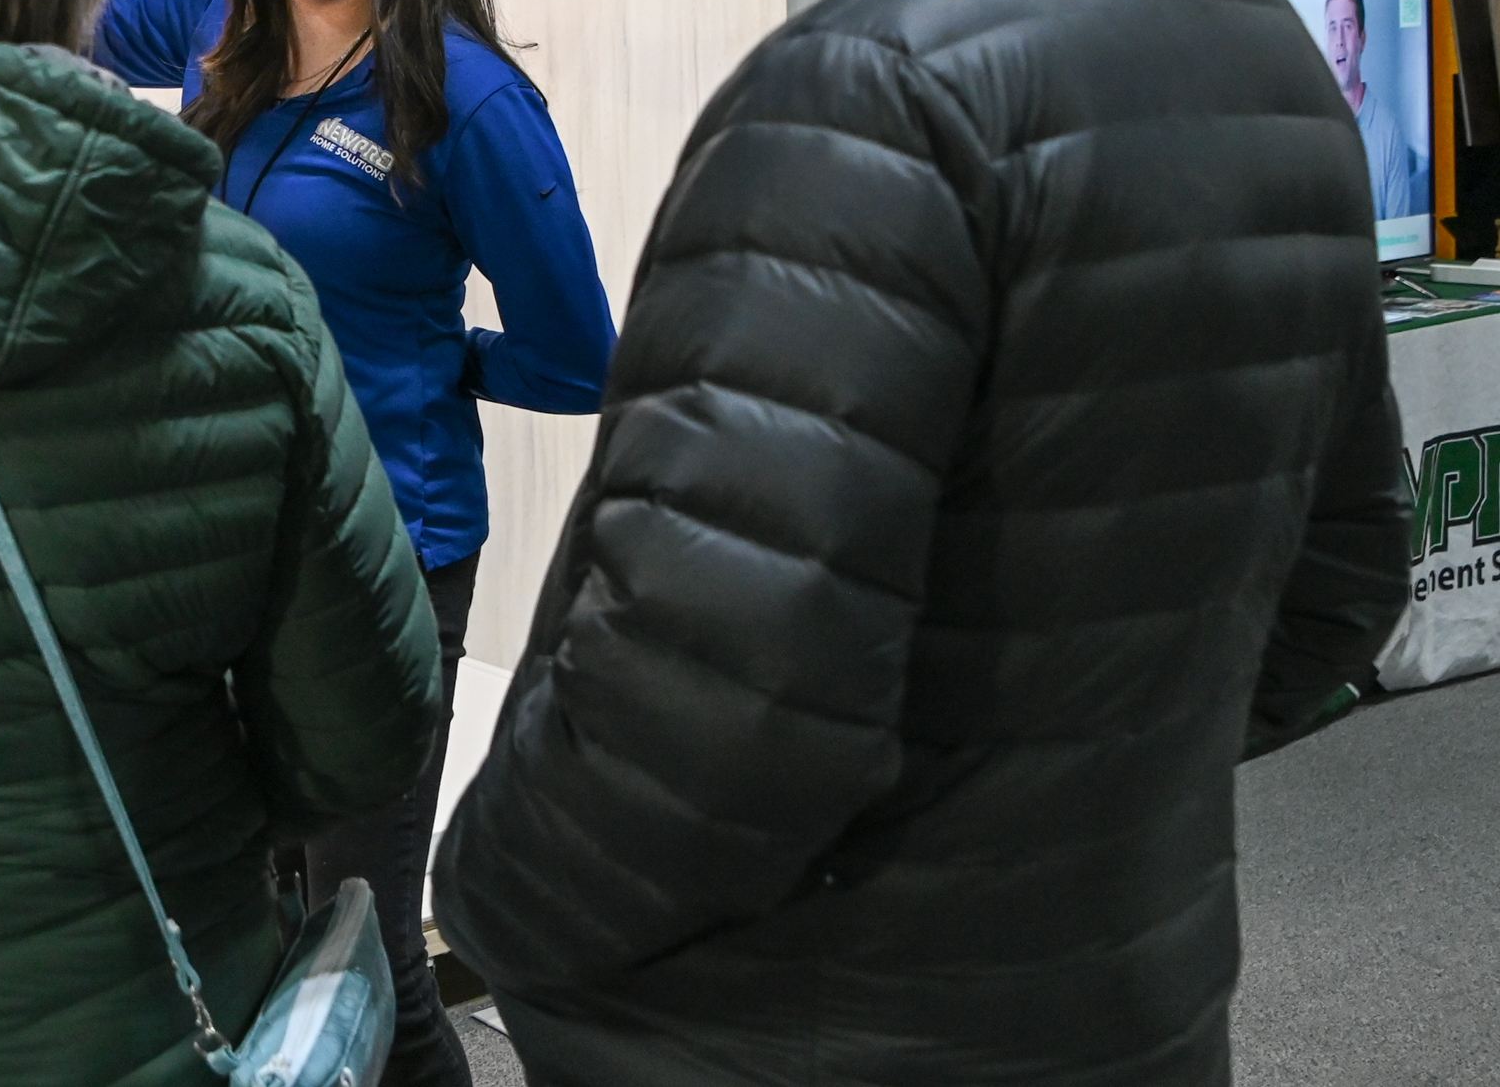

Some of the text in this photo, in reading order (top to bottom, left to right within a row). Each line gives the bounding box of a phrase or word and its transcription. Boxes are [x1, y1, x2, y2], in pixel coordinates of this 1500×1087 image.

[310, 134, 386, 182] HOME SOLUTIONS
[315, 117, 396, 172] NEWPRO
